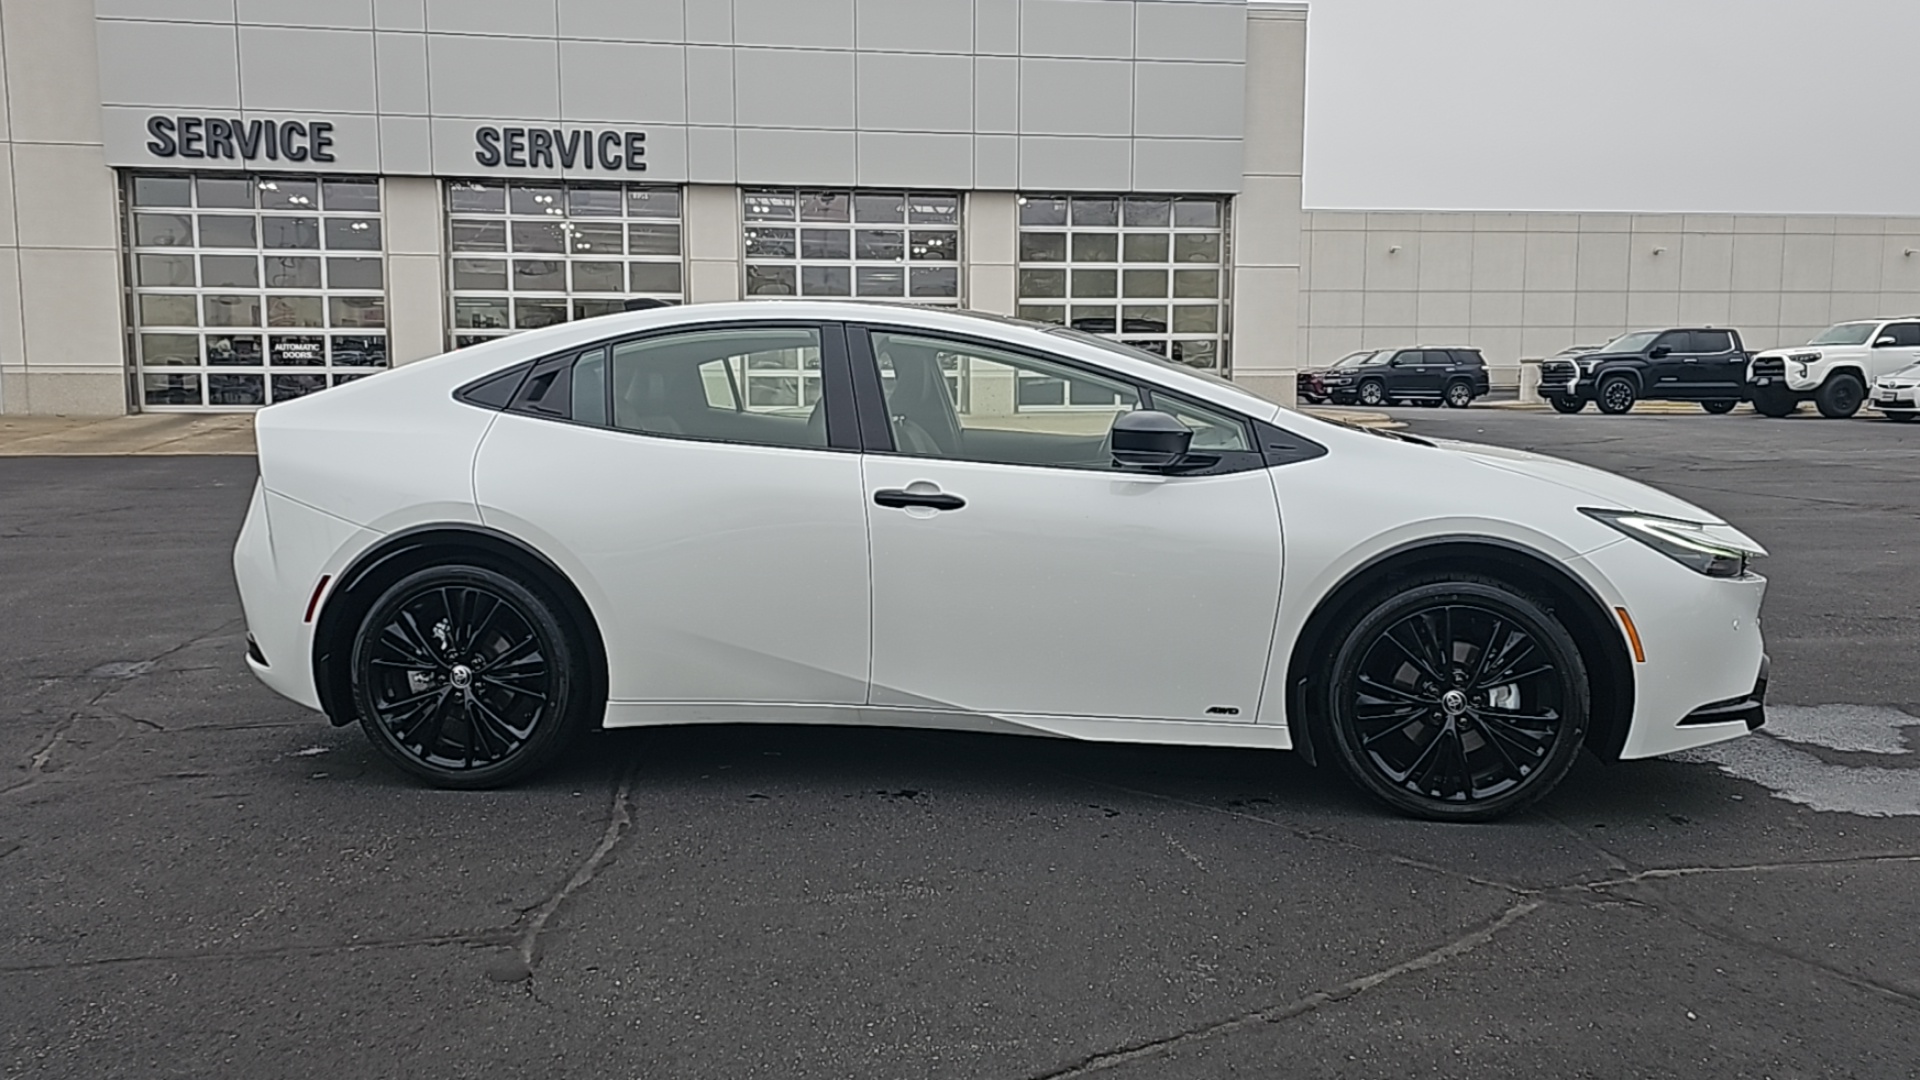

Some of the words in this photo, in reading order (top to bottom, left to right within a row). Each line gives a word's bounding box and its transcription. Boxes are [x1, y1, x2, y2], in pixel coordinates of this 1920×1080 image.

[147, 115, 336, 163] SERVICE
[475, 126, 647, 172] SERVICE
[274, 343, 320, 352] AUTOMATIC
[282, 351, 313, 359] DOORS
[1205, 706, 1239, 715] AWD
